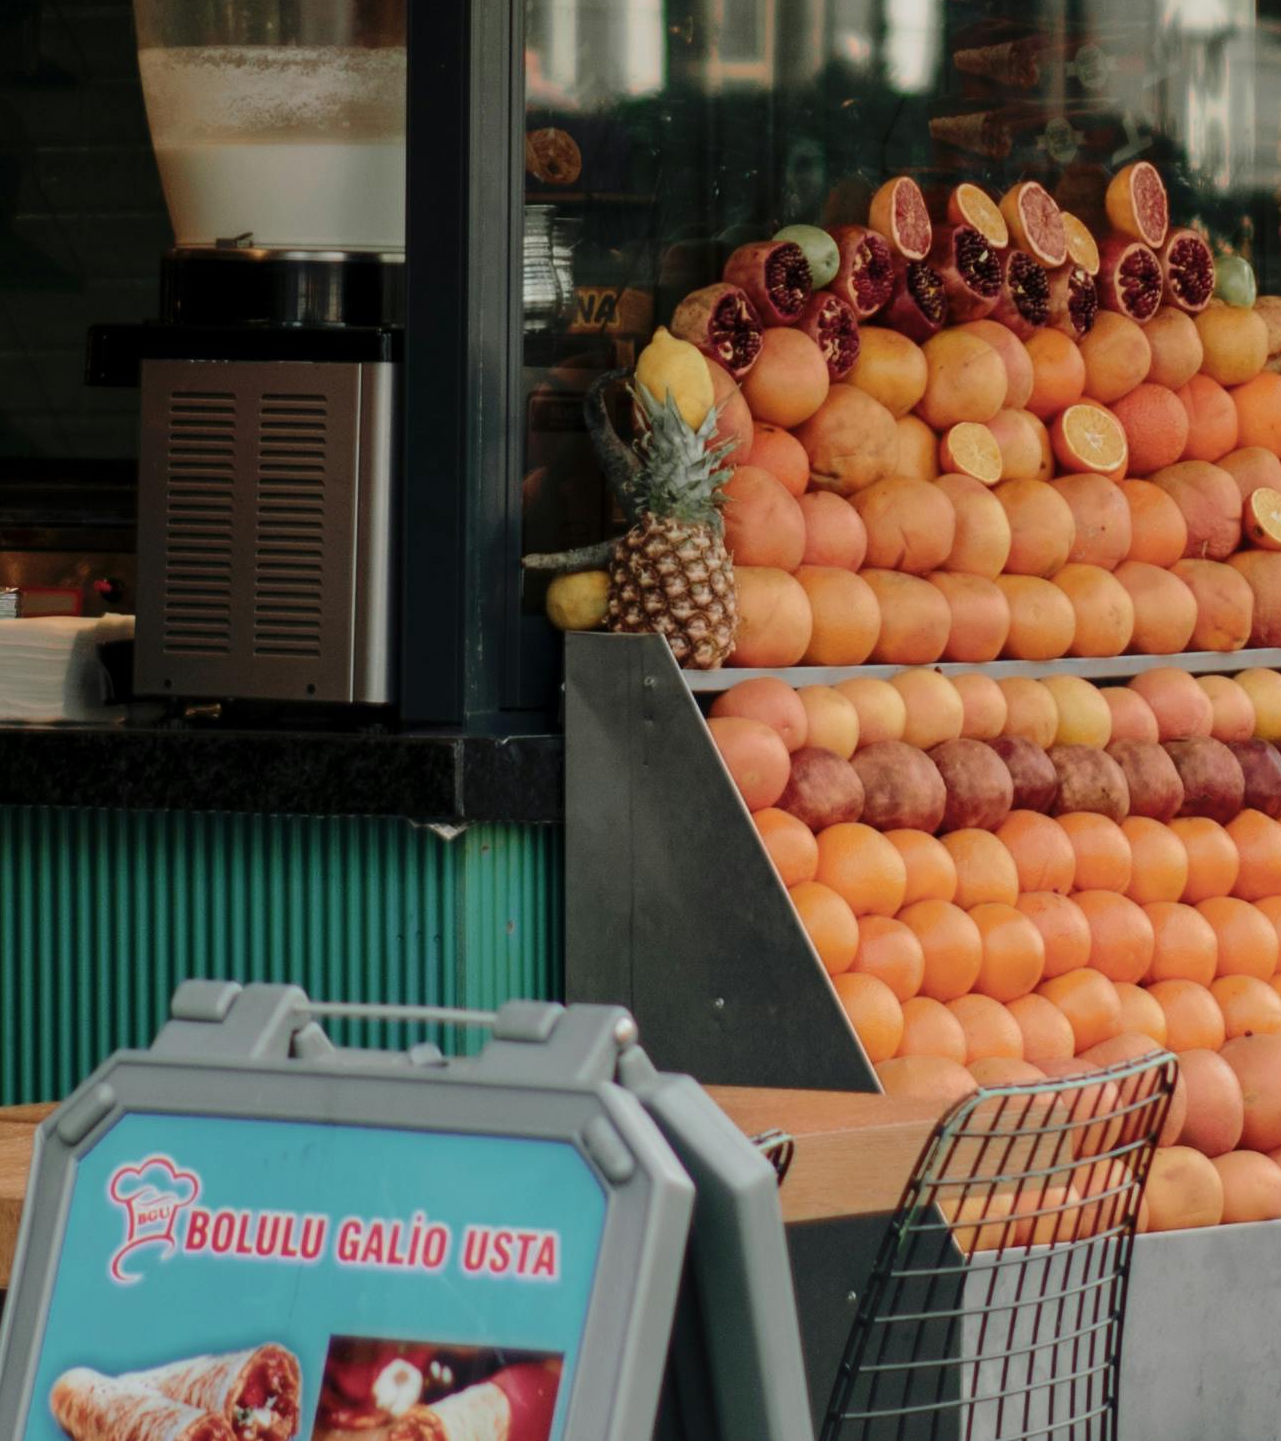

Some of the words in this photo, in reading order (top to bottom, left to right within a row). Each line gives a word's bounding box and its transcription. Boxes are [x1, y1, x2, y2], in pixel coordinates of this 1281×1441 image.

[183, 1209, 327, 1261] BOLULU
[336, 1210, 447, 1271] GALİO
[463, 1229, 558, 1278] USTA
